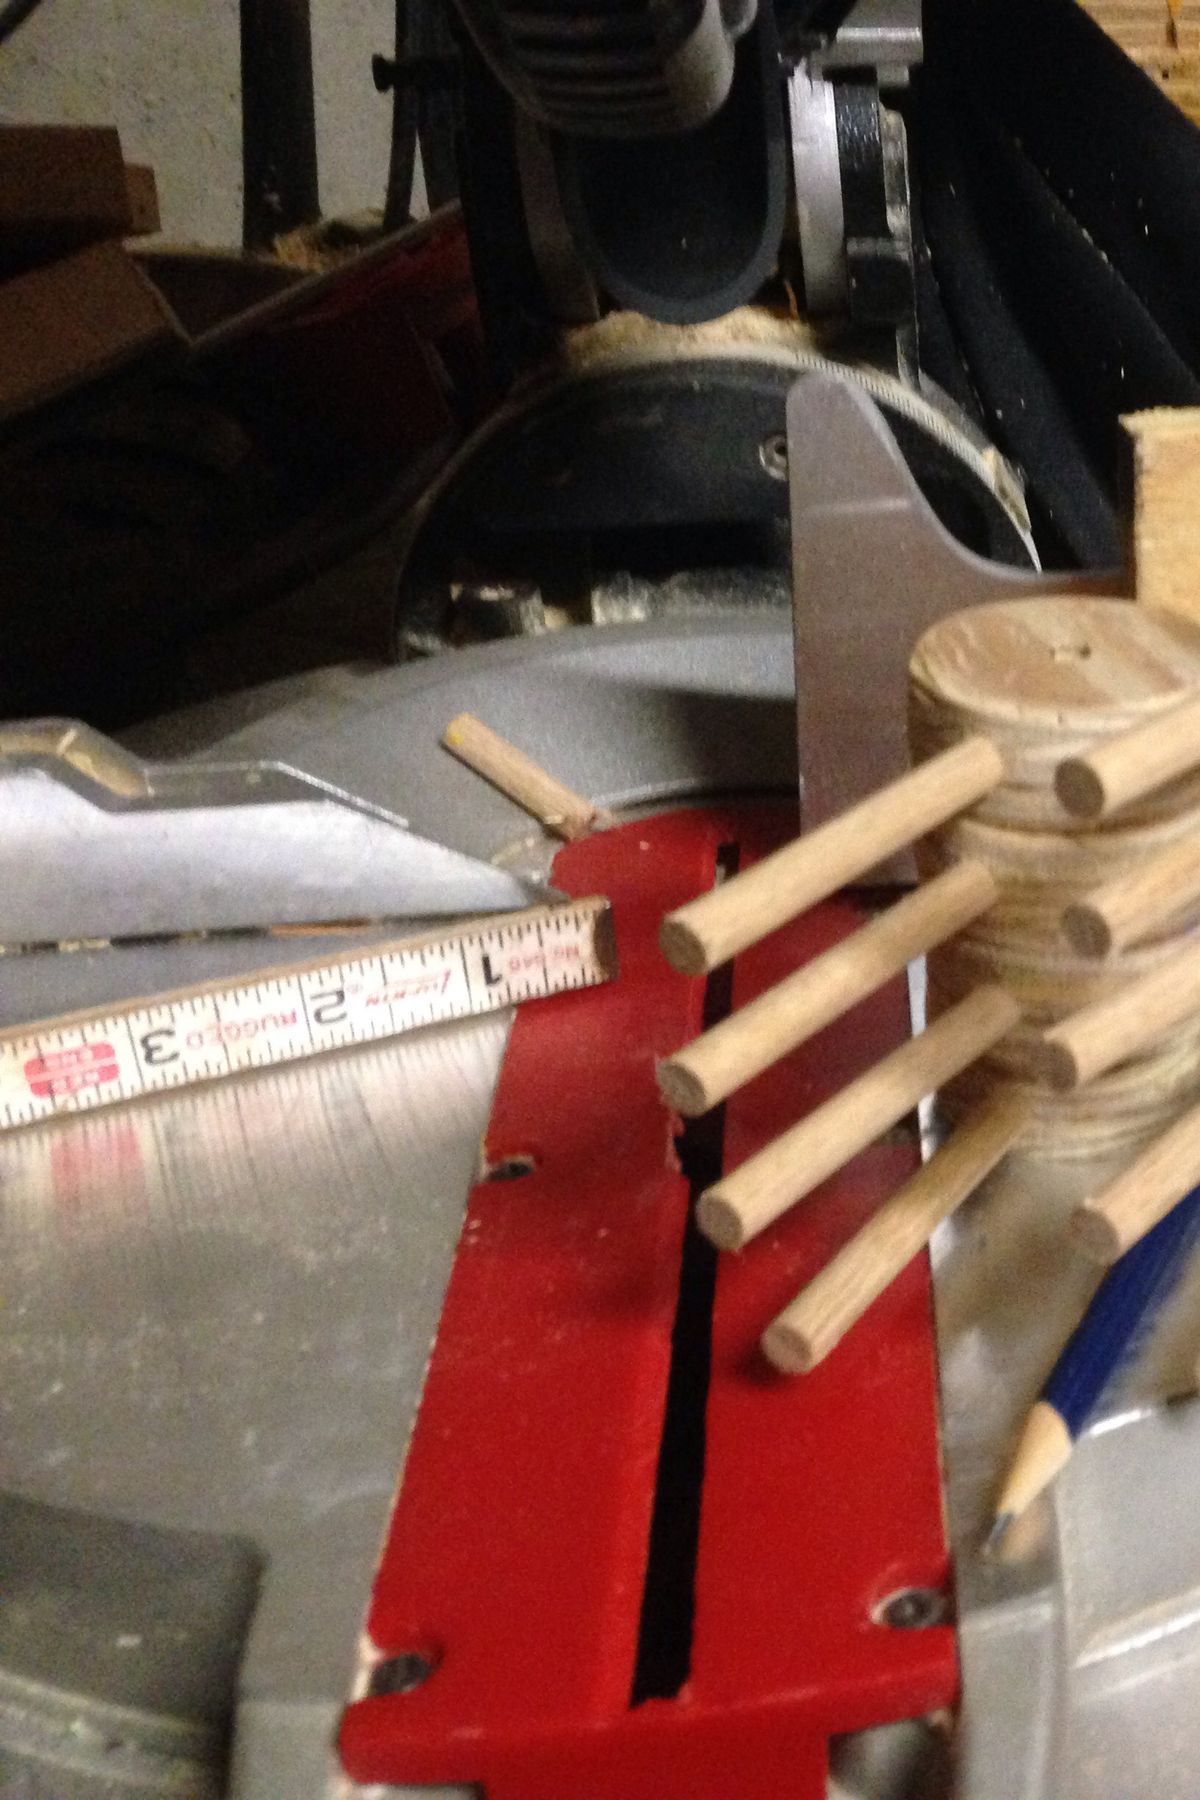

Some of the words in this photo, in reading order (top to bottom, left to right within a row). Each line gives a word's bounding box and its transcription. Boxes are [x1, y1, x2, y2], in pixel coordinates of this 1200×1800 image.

[483, 954, 502, 985] 1
[310, 989, 347, 1024] 2
[186, 1008, 297, 1047] RUGGED
[140, 1029, 180, 1065] 3
